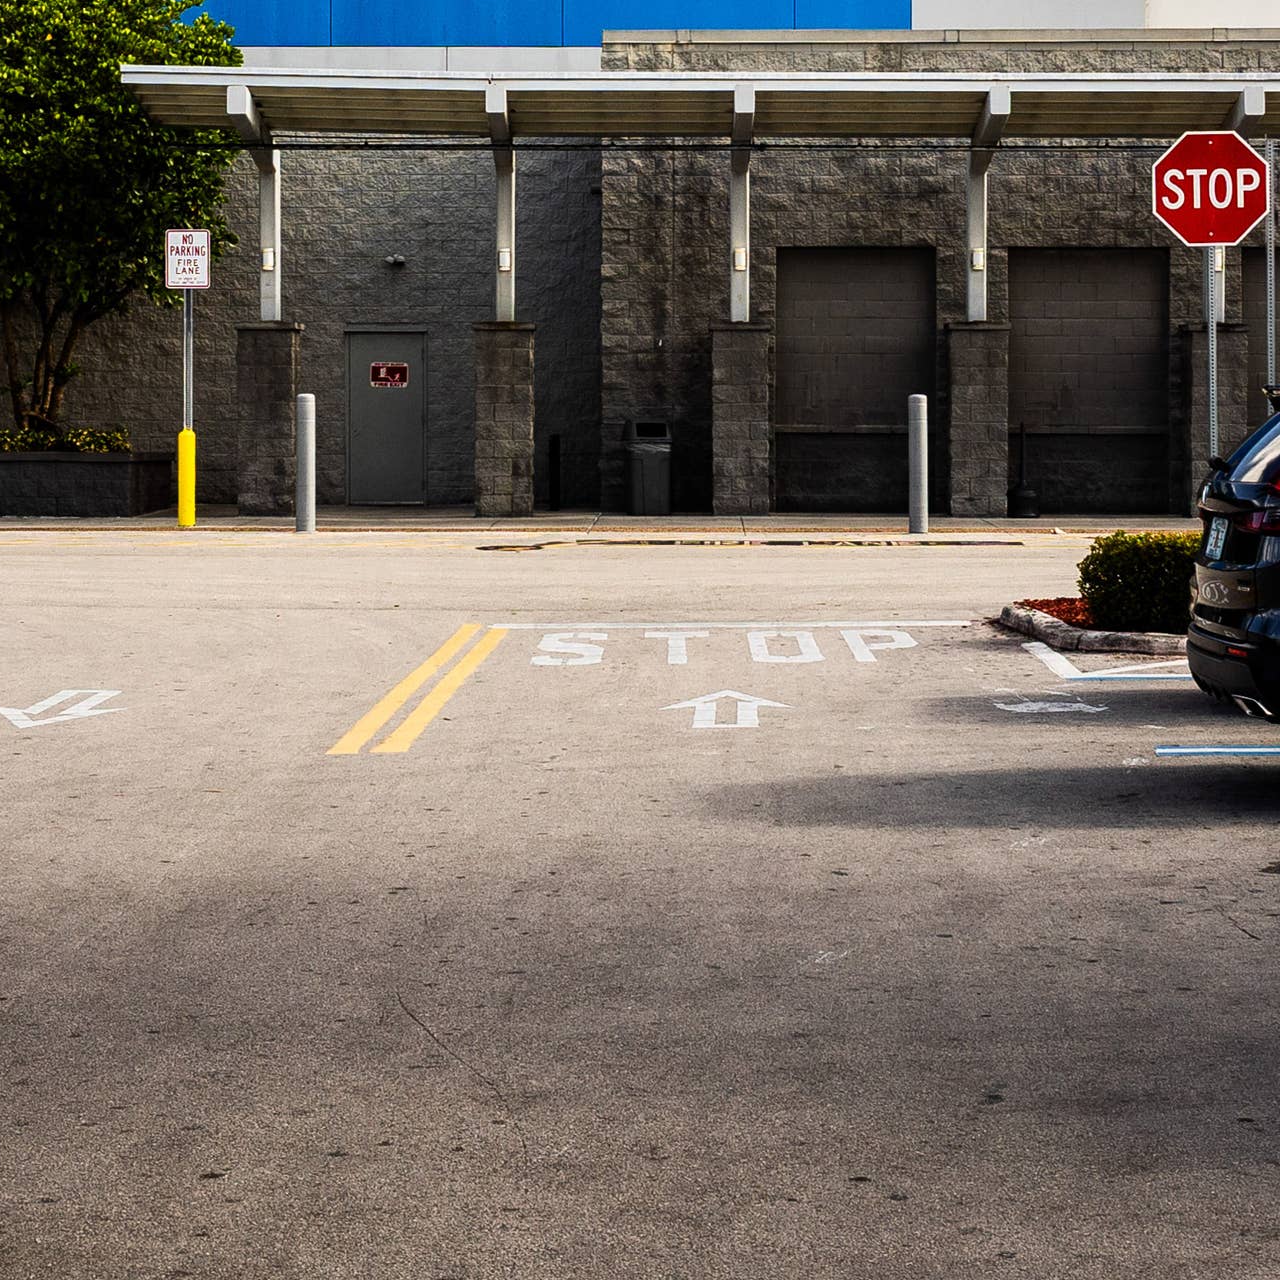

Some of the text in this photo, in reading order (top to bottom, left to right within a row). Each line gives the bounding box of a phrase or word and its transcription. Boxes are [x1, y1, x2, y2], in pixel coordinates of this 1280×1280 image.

[1161, 168, 1261, 210] STOP
[182, 234, 193, 245] NO
[170, 245, 206, 256] PARKING
[177, 259, 199, 267] FIRE
[176, 267, 201, 275] LANE
[530, 630, 918, 667] STOP
